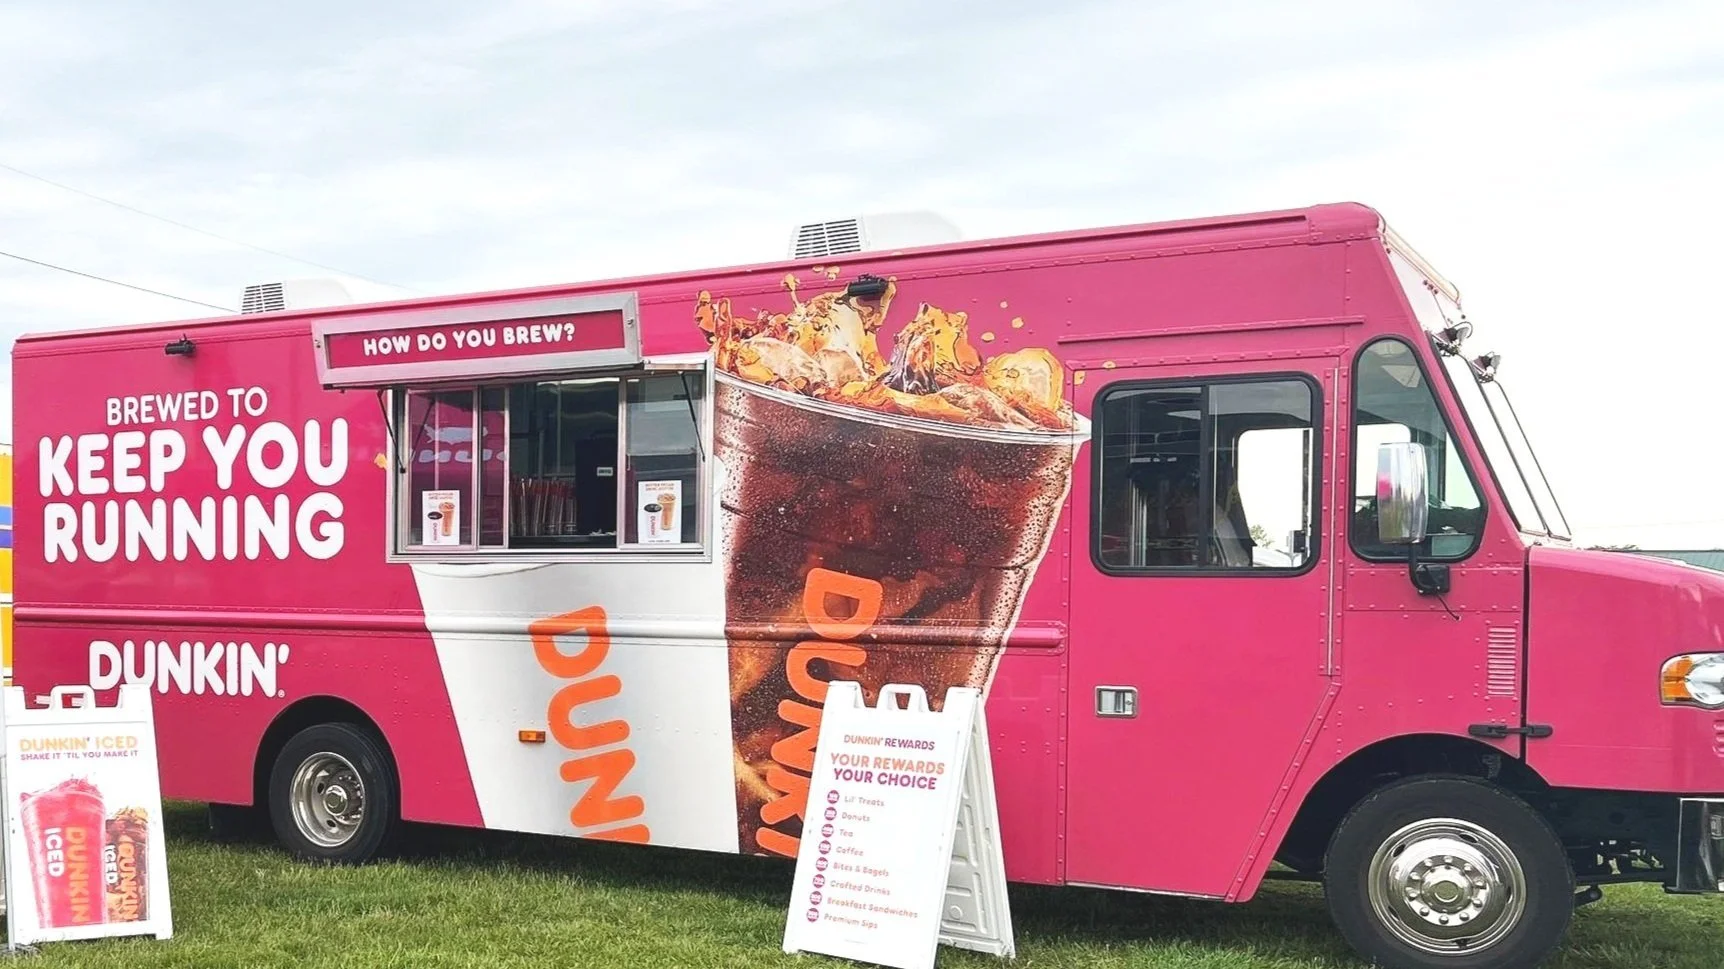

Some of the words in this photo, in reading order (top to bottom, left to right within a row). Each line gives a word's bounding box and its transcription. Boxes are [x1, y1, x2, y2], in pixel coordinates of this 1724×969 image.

[363, 335, 411, 356] HOW
[416, 332, 447, 352] DO
[452, 327, 496, 349] YOU
[502, 322, 575, 345] BREW?
[106, 390, 219, 426] BREWED
[227, 386, 268, 417] TO
[38, 428, 187, 497] KEEP
[202, 417, 349, 490] YOU
[43, 491, 345, 563] RUNNING
[89, 639, 290, 698] DUNKIN'
[19, 737, 90, 752] DUNKIN'
[95, 736, 138, 749] ICED
[843, 734, 883, 746] DUNKIN'
[884, 737, 935, 751] REWARDS
[20, 752, 50, 761] SHAKE
[52, 752, 61, 760] IT
[83, 750, 101, 759] YOU
[103, 750, 128, 758] MAKE
[130, 750, 138, 758] IT
[830, 752, 870, 768] YOUR
[873, 756, 945, 775] REWARDS
[833, 768, 873, 784] YOUR
[877, 772, 937, 790] CHOICE
[858, 797, 885, 807] Treats
[841, 811, 871, 822] Donuts
[839, 828, 854, 838] Tea
[45, 828, 65, 877] ICED
[836, 846, 864, 857] Coffee
[104, 844, 118, 885] ICED
[833, 861, 853, 872] Bites
[863, 866, 889, 877] Bagels
[830, 880, 863, 892] Crafted
[864, 885, 891, 896] Drinks
[827, 896, 867, 911] Breakfast
[868, 903, 919, 919] Sandwiches
[824, 913, 860, 926] Premium
[861, 919, 878, 930] Sips
